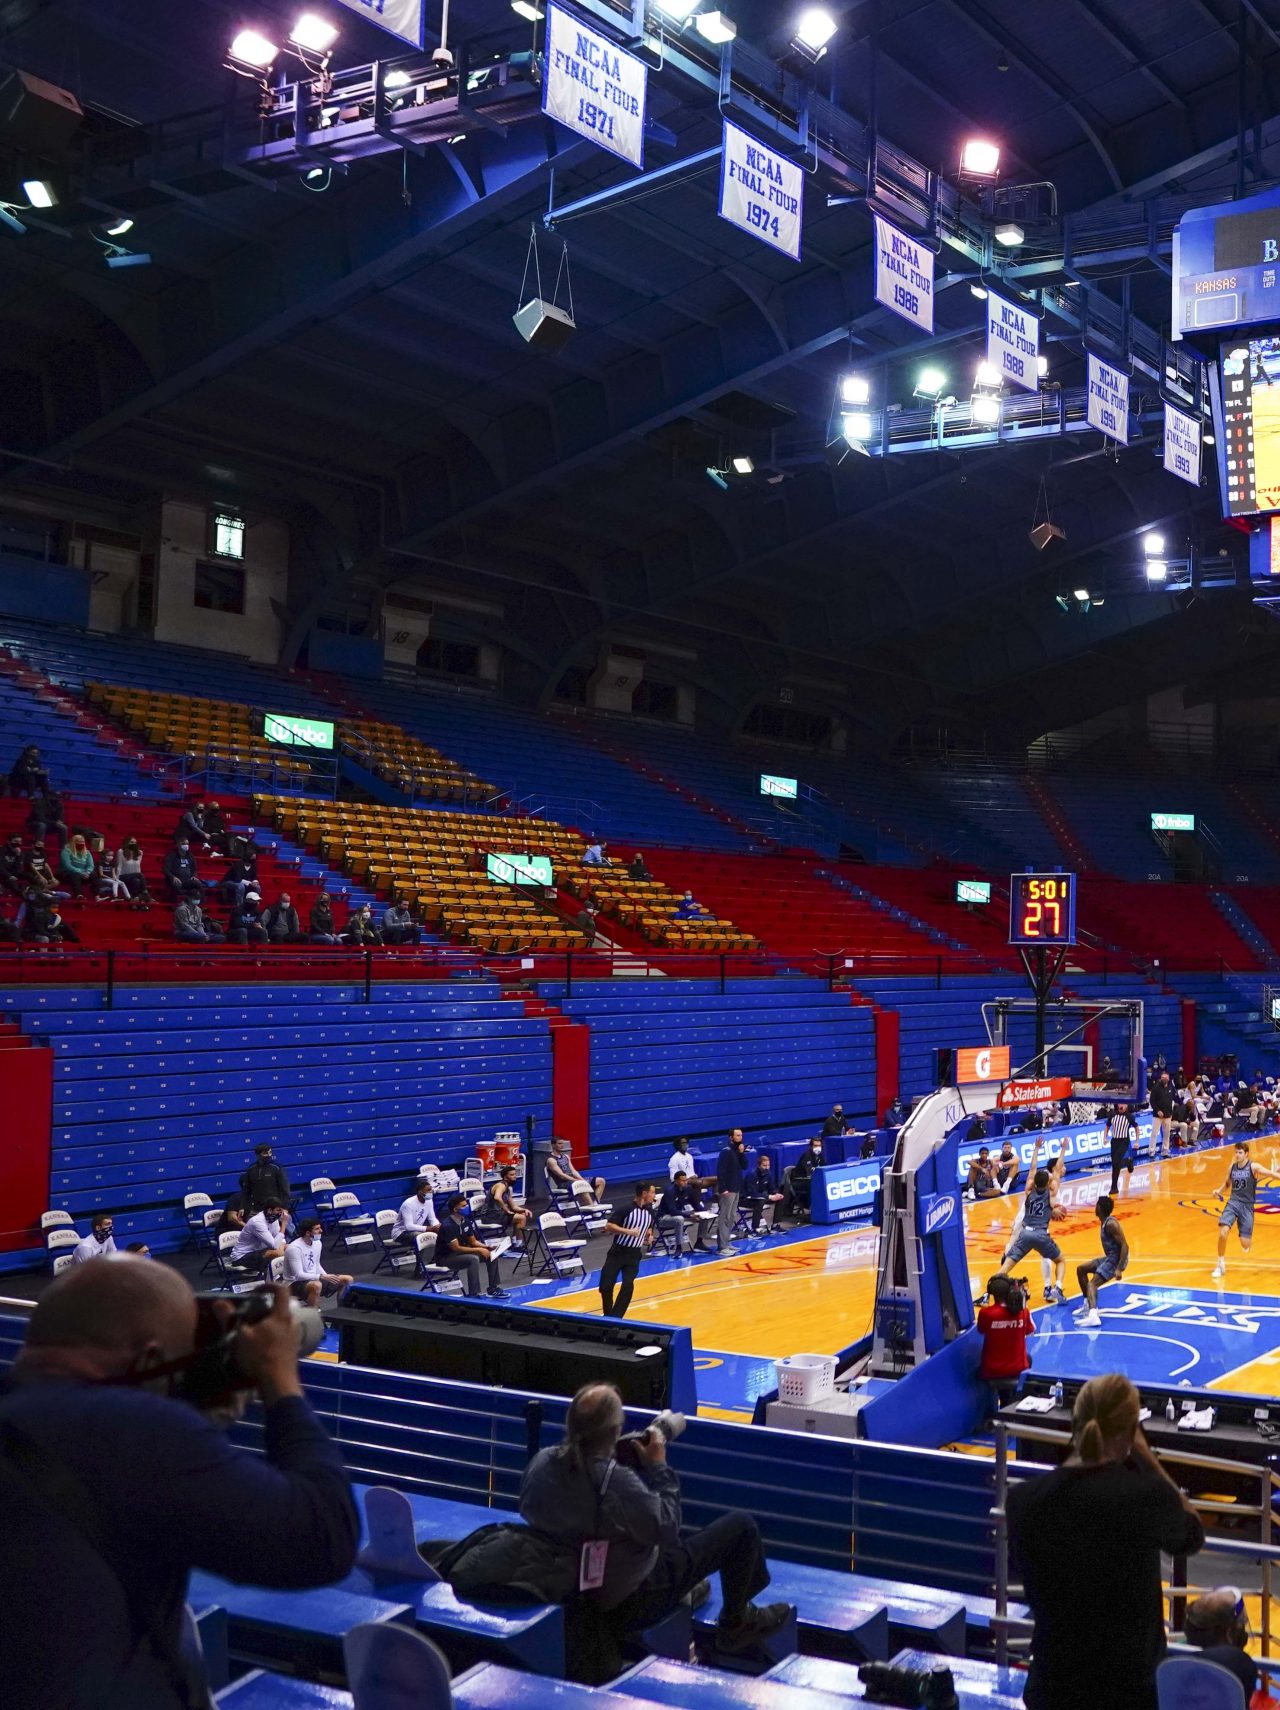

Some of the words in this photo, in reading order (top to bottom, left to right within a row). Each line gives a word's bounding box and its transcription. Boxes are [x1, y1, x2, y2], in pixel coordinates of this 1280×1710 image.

[576, 32, 621, 82] NCAA
[555, 51, 598, 97] FINAL
[604, 84, 639, 117] FOUR
[578, 97, 615, 140] 1971
[746, 144, 783, 185] NCAA
[729, 160, 765, 197] FINAL
[769, 187, 798, 215] FOUR
[746, 201, 779, 238] 1974
[891, 233, 920, 269] NCAA
[881, 250, 908, 279] FINAL
[910, 269, 930, 295] FOUR
[1195, 277, 1236, 294] KANSAS
[894, 283, 919, 316] 1986
[1001, 305, 1026, 335] NCAA
[990, 320, 1014, 346] FINAL
[1016, 339, 1036, 357] FOUR
[1002, 350, 1024, 377] 1988
[1029, 880, 1066, 899] 5:01
[1024, 902, 1059, 935] 27
[975, 1050, 991, 1078] G
[945, 1104, 961, 1122] KU
[1076, 1130, 1112, 1153] GEIC
[826, 1174, 881, 1201] GEICO
[1234, 1179, 1247, 1190] 23
[839, 1209, 858, 1219] ROCKET
[1028, 1200, 1044, 1217] 12
[991, 1320, 1017, 1329] ESPN
